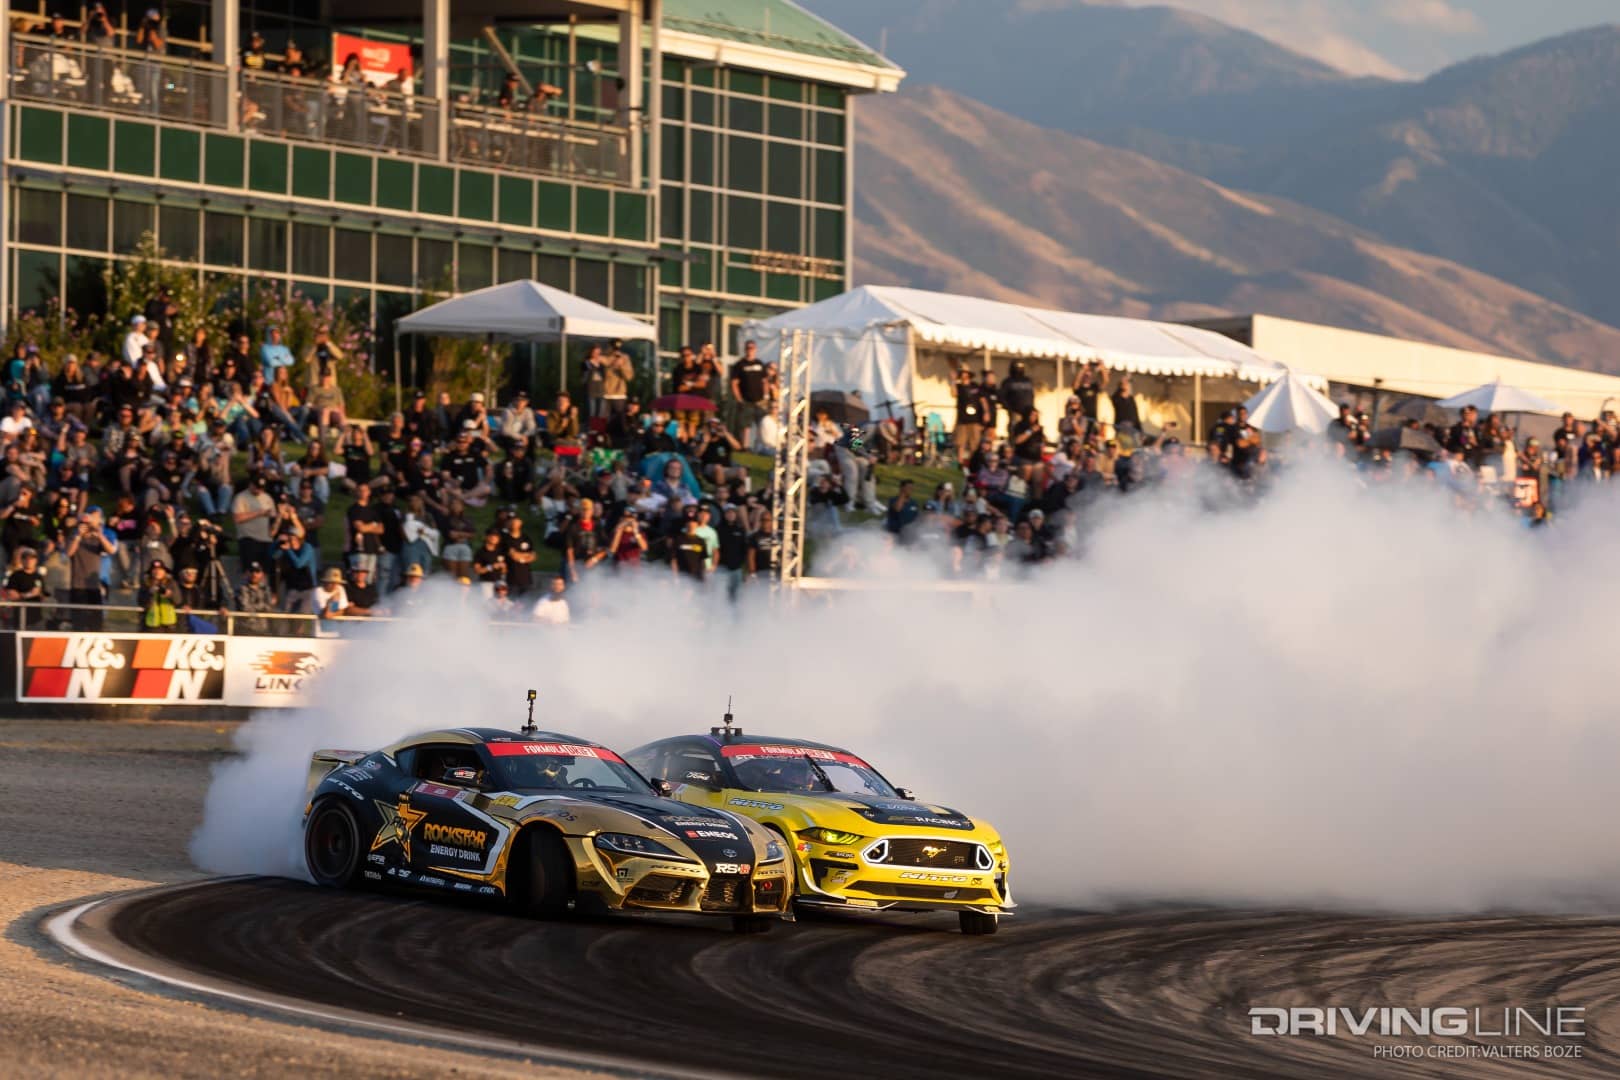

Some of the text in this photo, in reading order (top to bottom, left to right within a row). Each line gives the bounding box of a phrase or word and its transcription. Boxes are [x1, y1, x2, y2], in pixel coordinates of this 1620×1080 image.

[523, 745, 567, 754] FORMULA
[729, 797, 785, 811] NITTO
[423, 822, 487, 850] ROCKSTAR
[696, 830, 739, 840] ENEOS
[430, 843, 481, 862] ENERGY DRINK
[900, 871, 968, 883] NITTO
